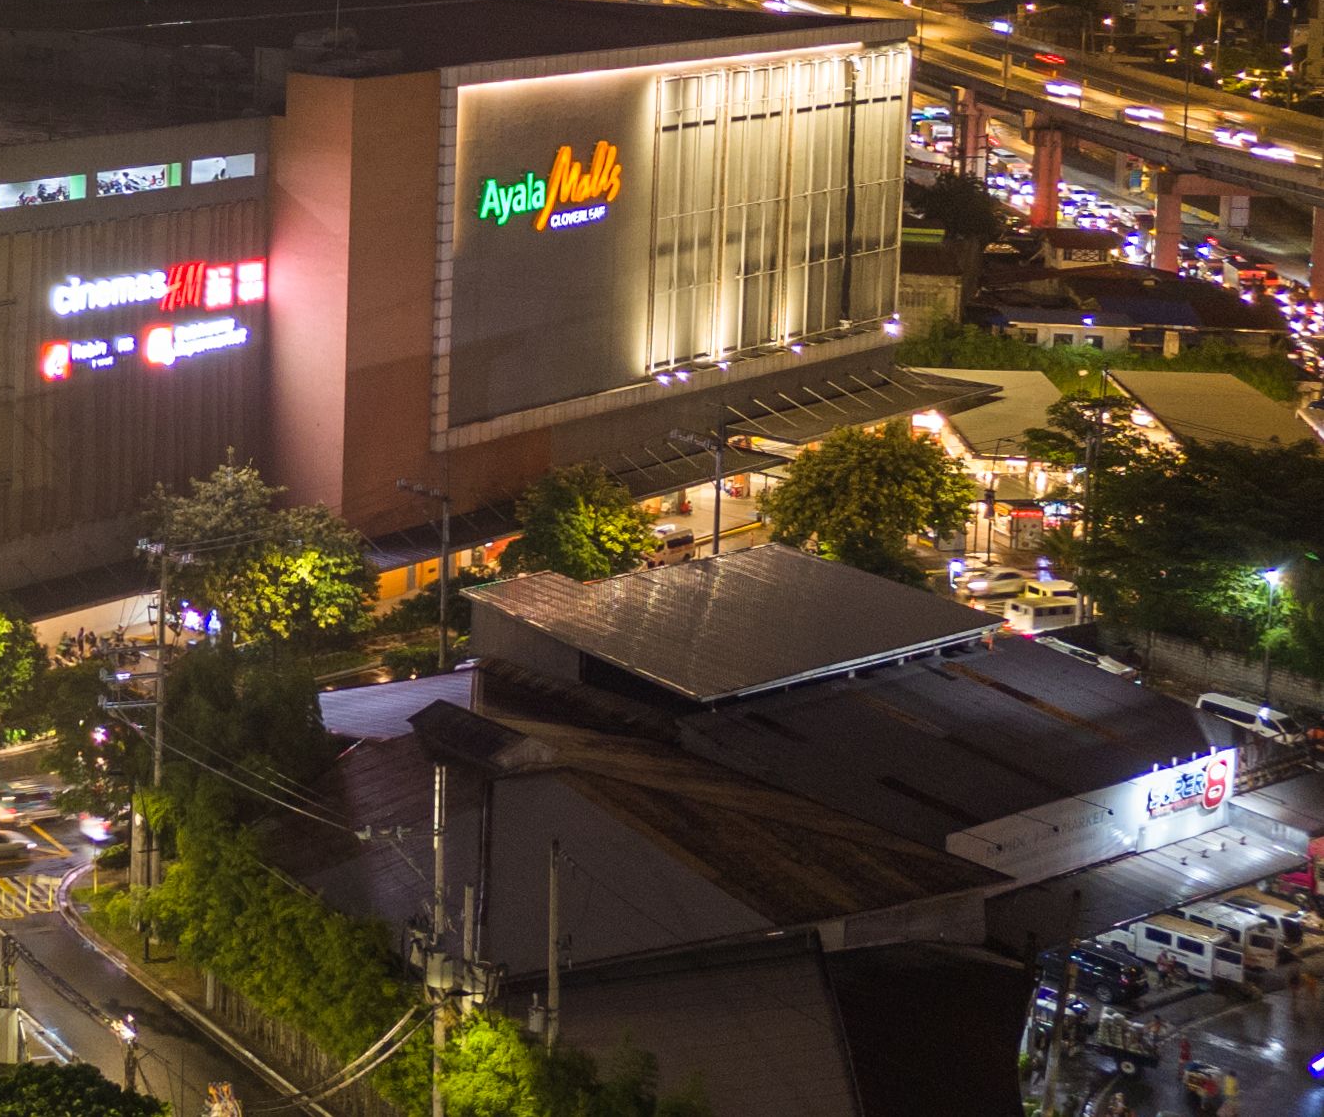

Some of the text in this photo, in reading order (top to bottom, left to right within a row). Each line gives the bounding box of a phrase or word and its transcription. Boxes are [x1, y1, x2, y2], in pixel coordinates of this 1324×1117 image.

[479, 140, 623, 232] Ayala Malls
[51, 269, 168, 316] cinemas
[1202, 759, 1228, 810] 8
